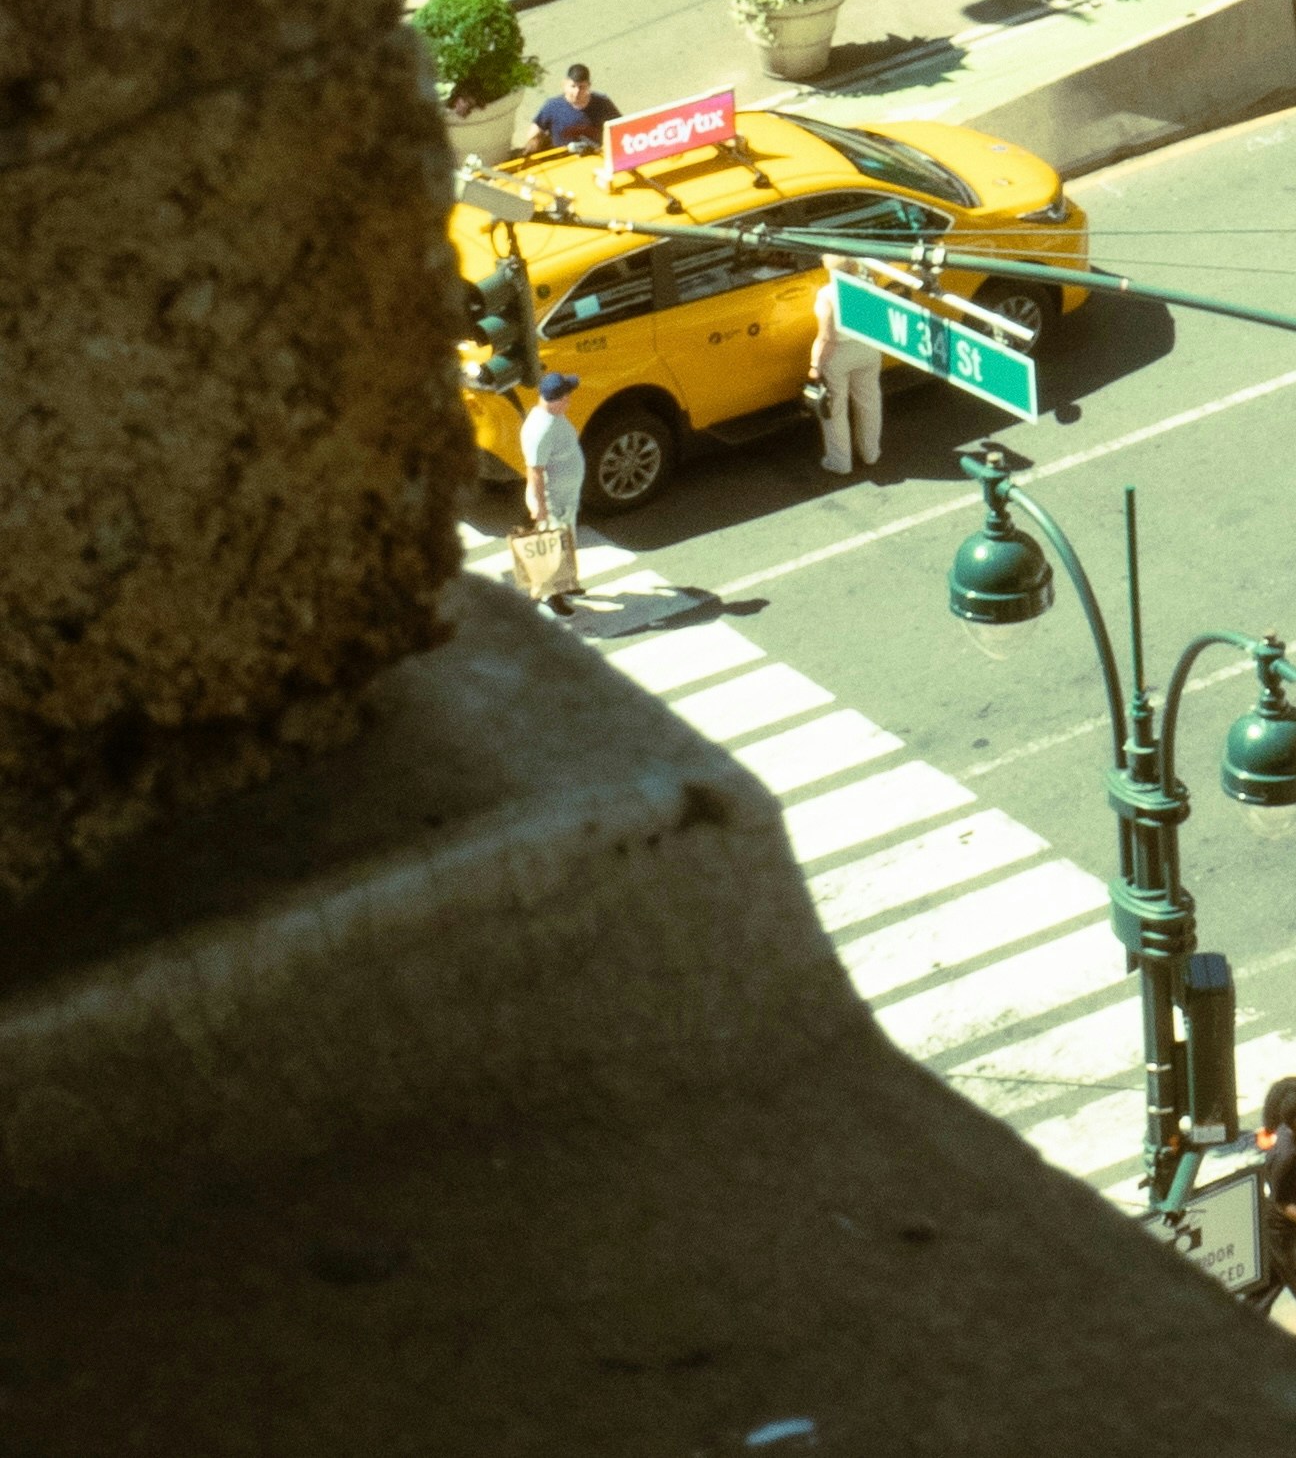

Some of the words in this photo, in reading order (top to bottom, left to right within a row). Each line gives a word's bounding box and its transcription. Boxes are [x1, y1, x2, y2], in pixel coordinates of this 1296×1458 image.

[888, 308, 908, 347] W
[916, 321, 948, 366] 34
[956, 340, 983, 382] St
